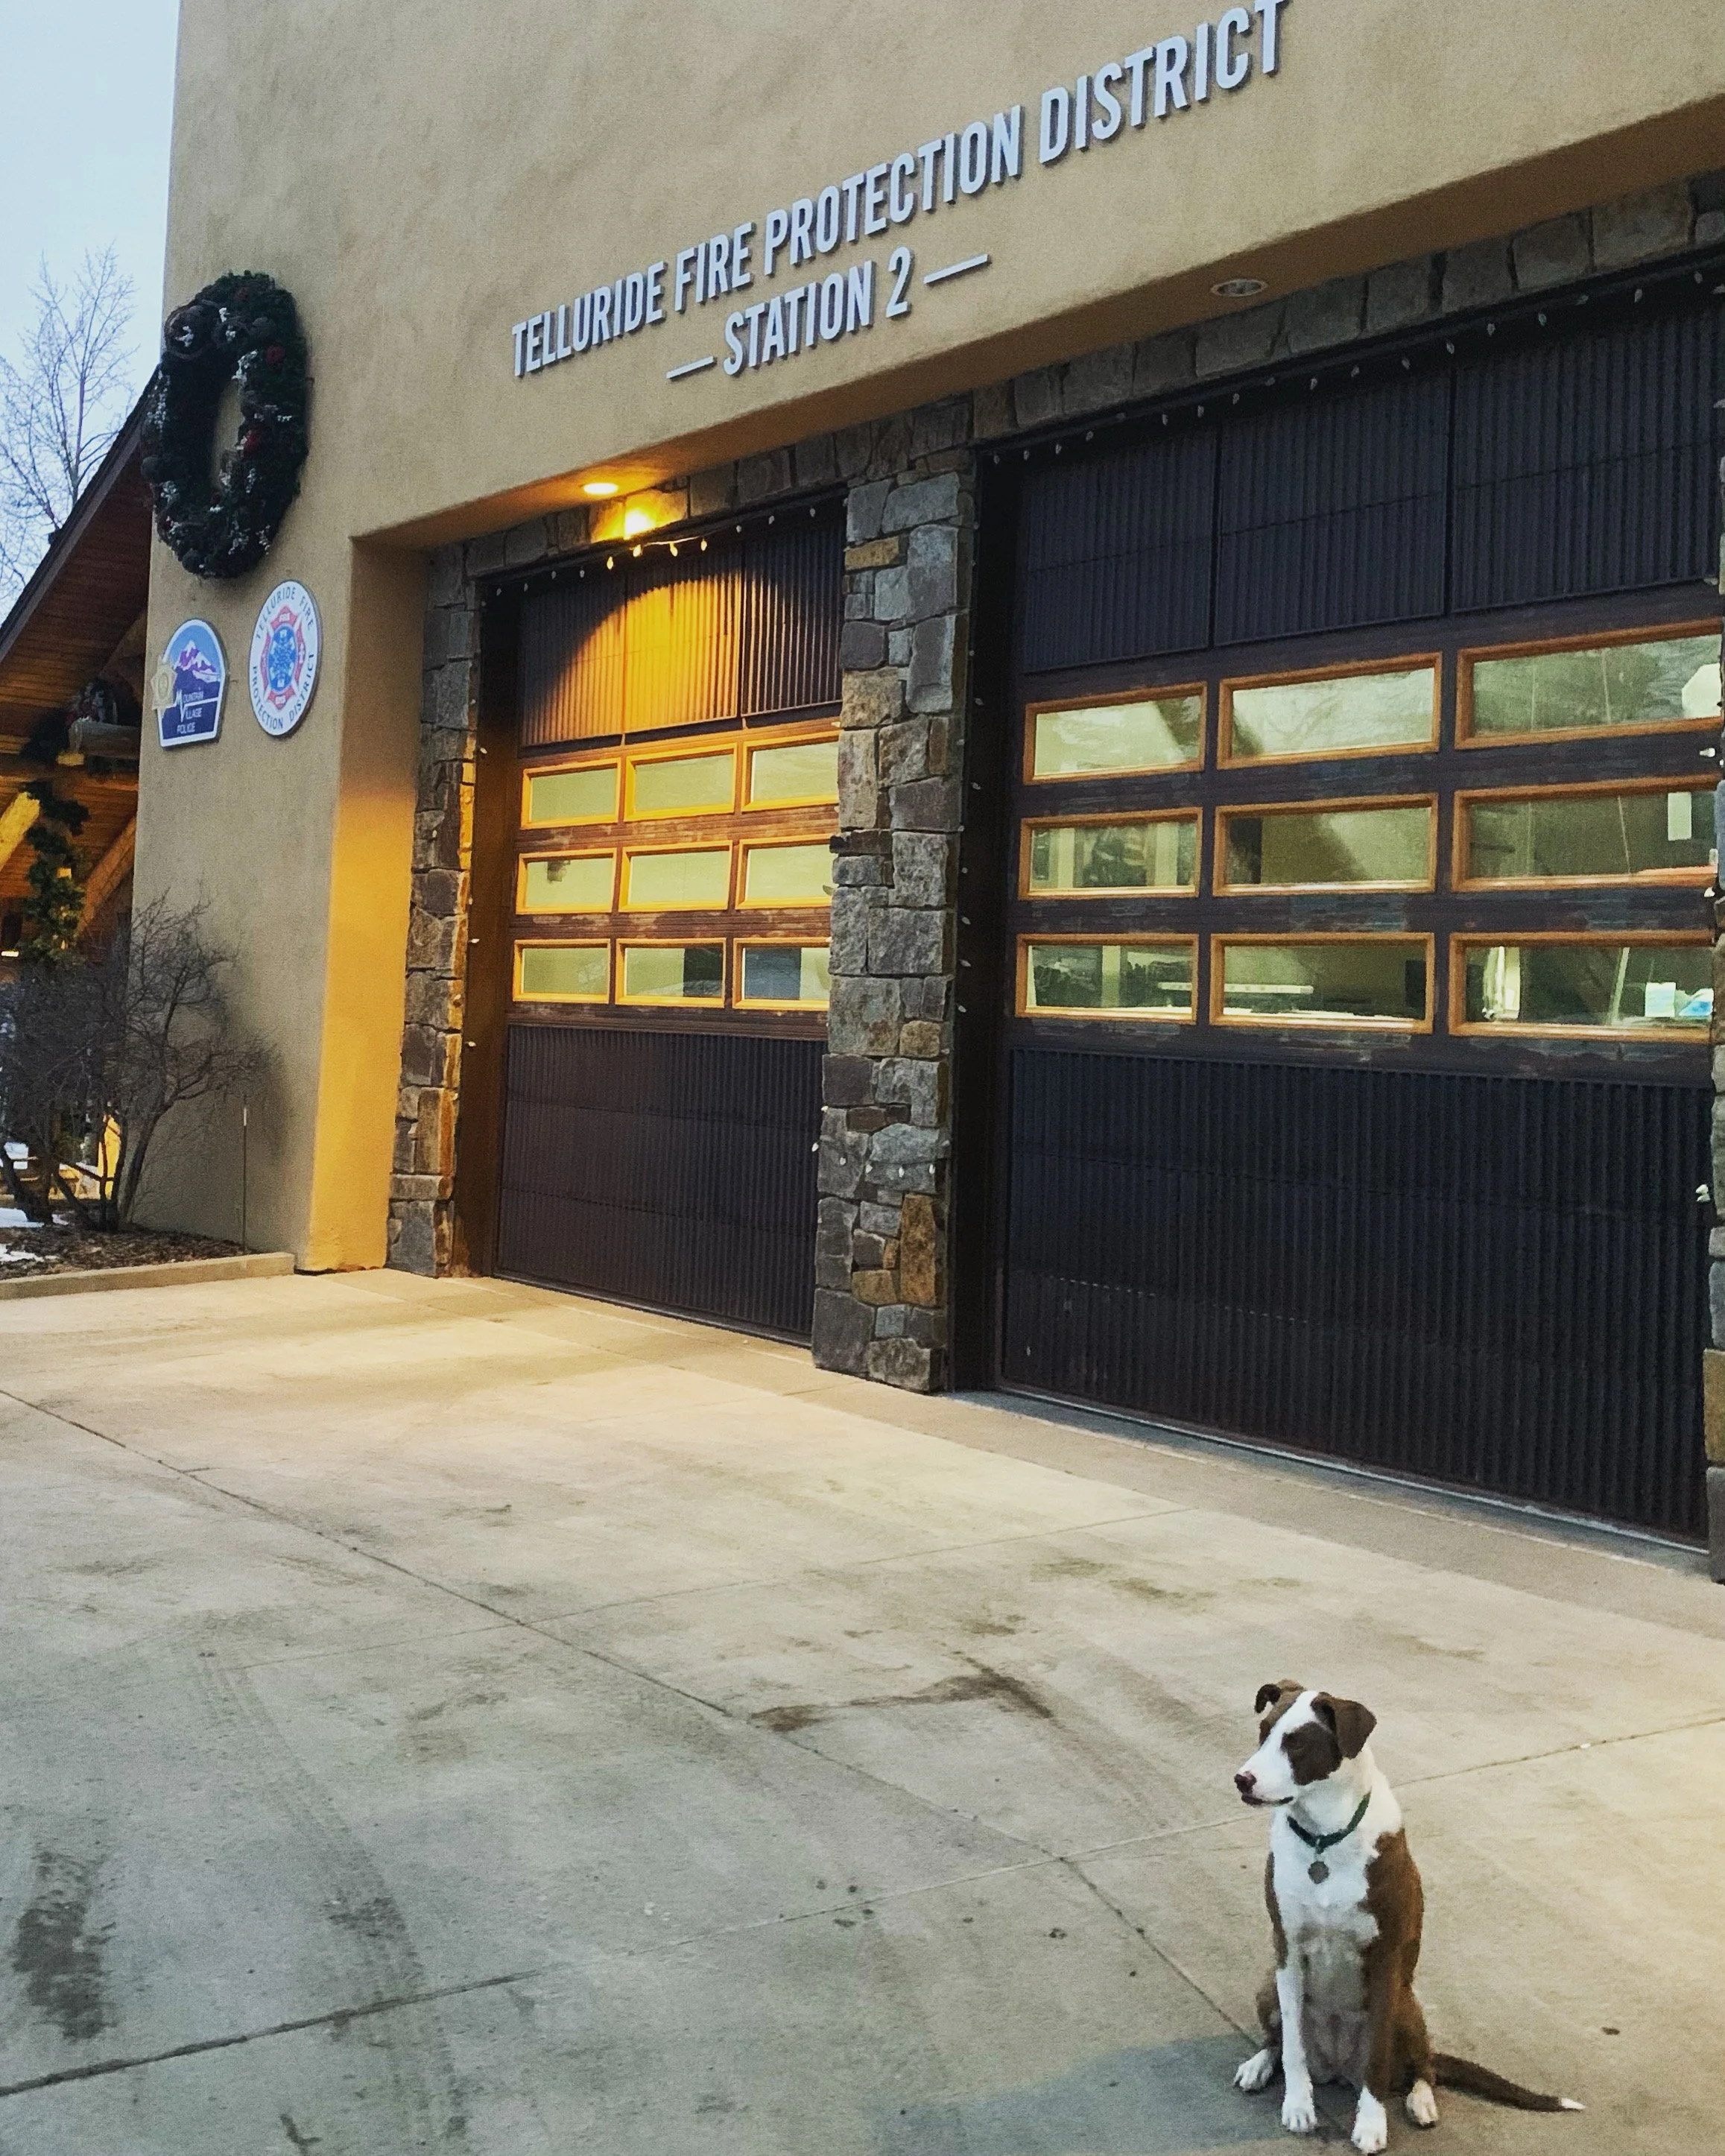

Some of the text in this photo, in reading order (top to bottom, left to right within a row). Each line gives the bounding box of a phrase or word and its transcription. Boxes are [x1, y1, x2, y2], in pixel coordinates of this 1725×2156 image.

[511, 0, 1285, 377] TELLURIDE FIRE PROTECTION DISTRICT
[723, 245, 914, 376] STATION 2
[255, 586, 314, 639] TELLURIDE FIRE
[180, 705, 202, 722] VILLAGE
[252, 653, 315, 729] PROTECTION DISTRICT
[176, 722, 195, 734] POLICE
